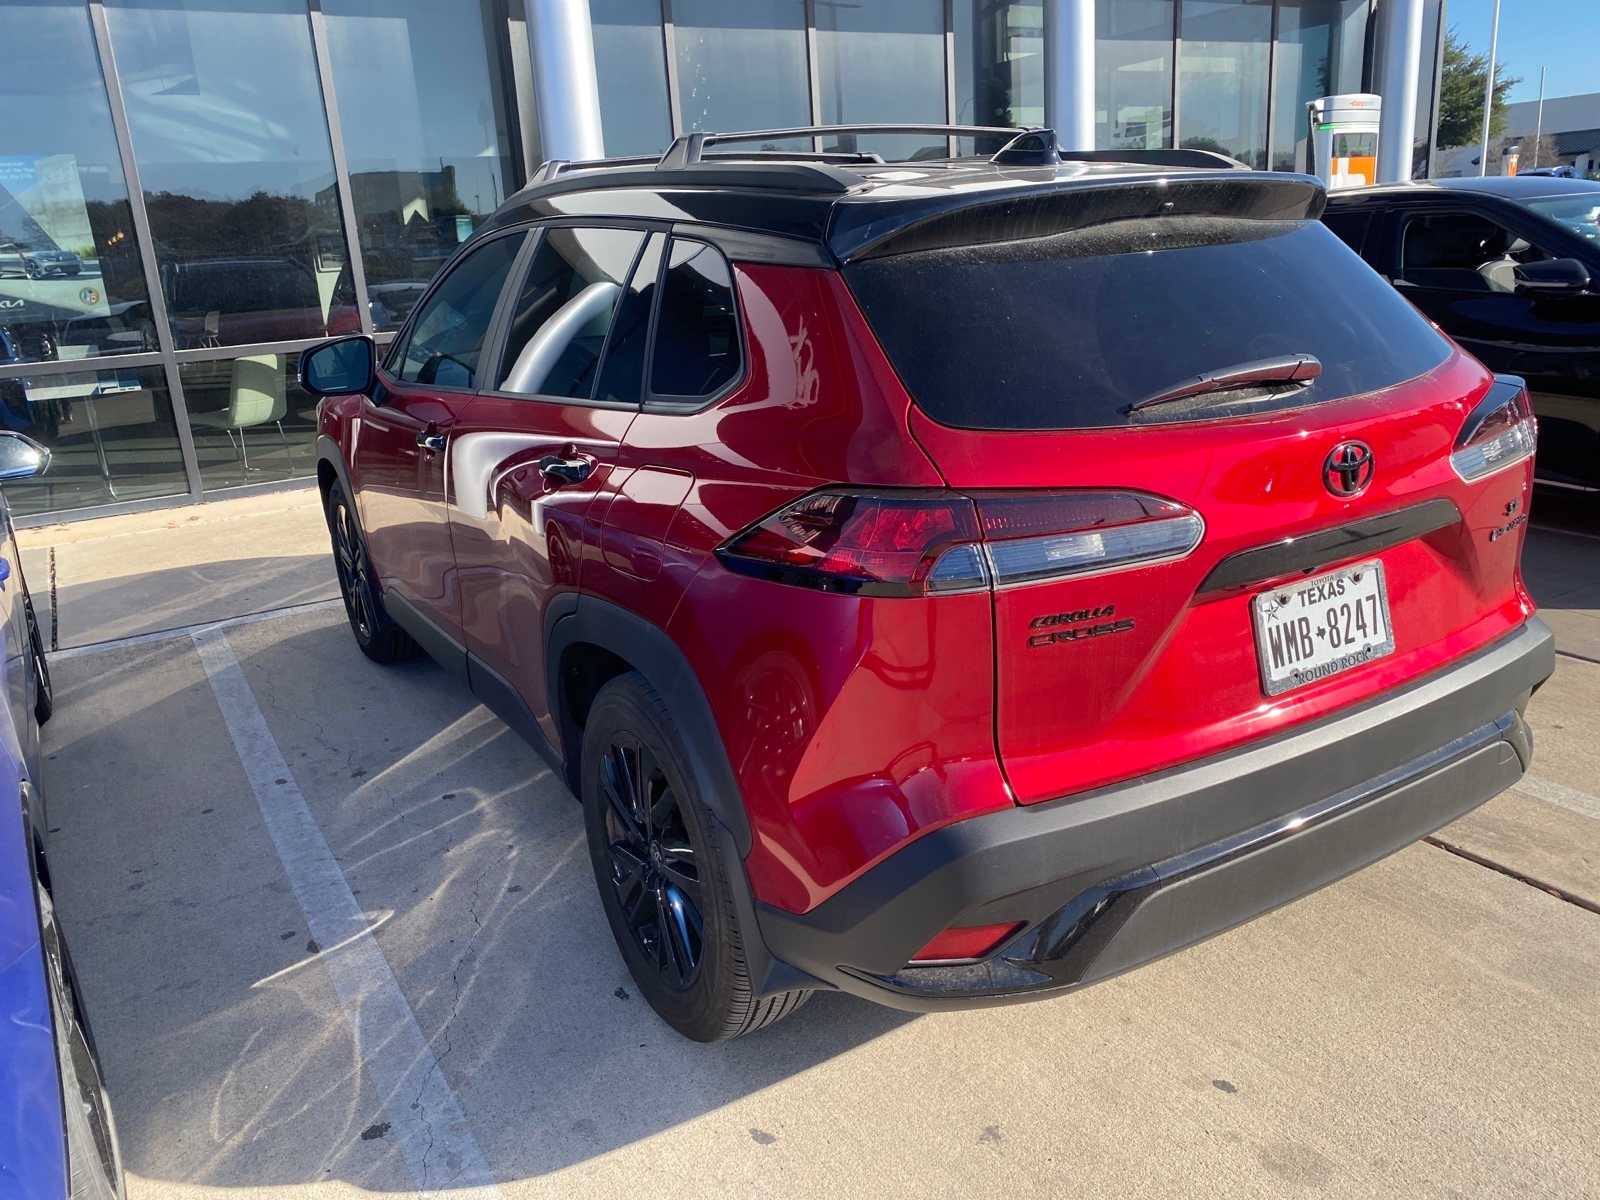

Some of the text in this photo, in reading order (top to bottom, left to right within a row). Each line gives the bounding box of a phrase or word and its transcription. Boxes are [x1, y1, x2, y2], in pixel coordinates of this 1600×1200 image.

[1297, 578, 1346, 608] TEXAS
[1029, 604, 1115, 629] COROLLA
[1268, 594, 1378, 669] WMB 8247
[1028, 619, 1135, 648] CROSS
[1298, 649, 1370, 684] ROUND ROCK
